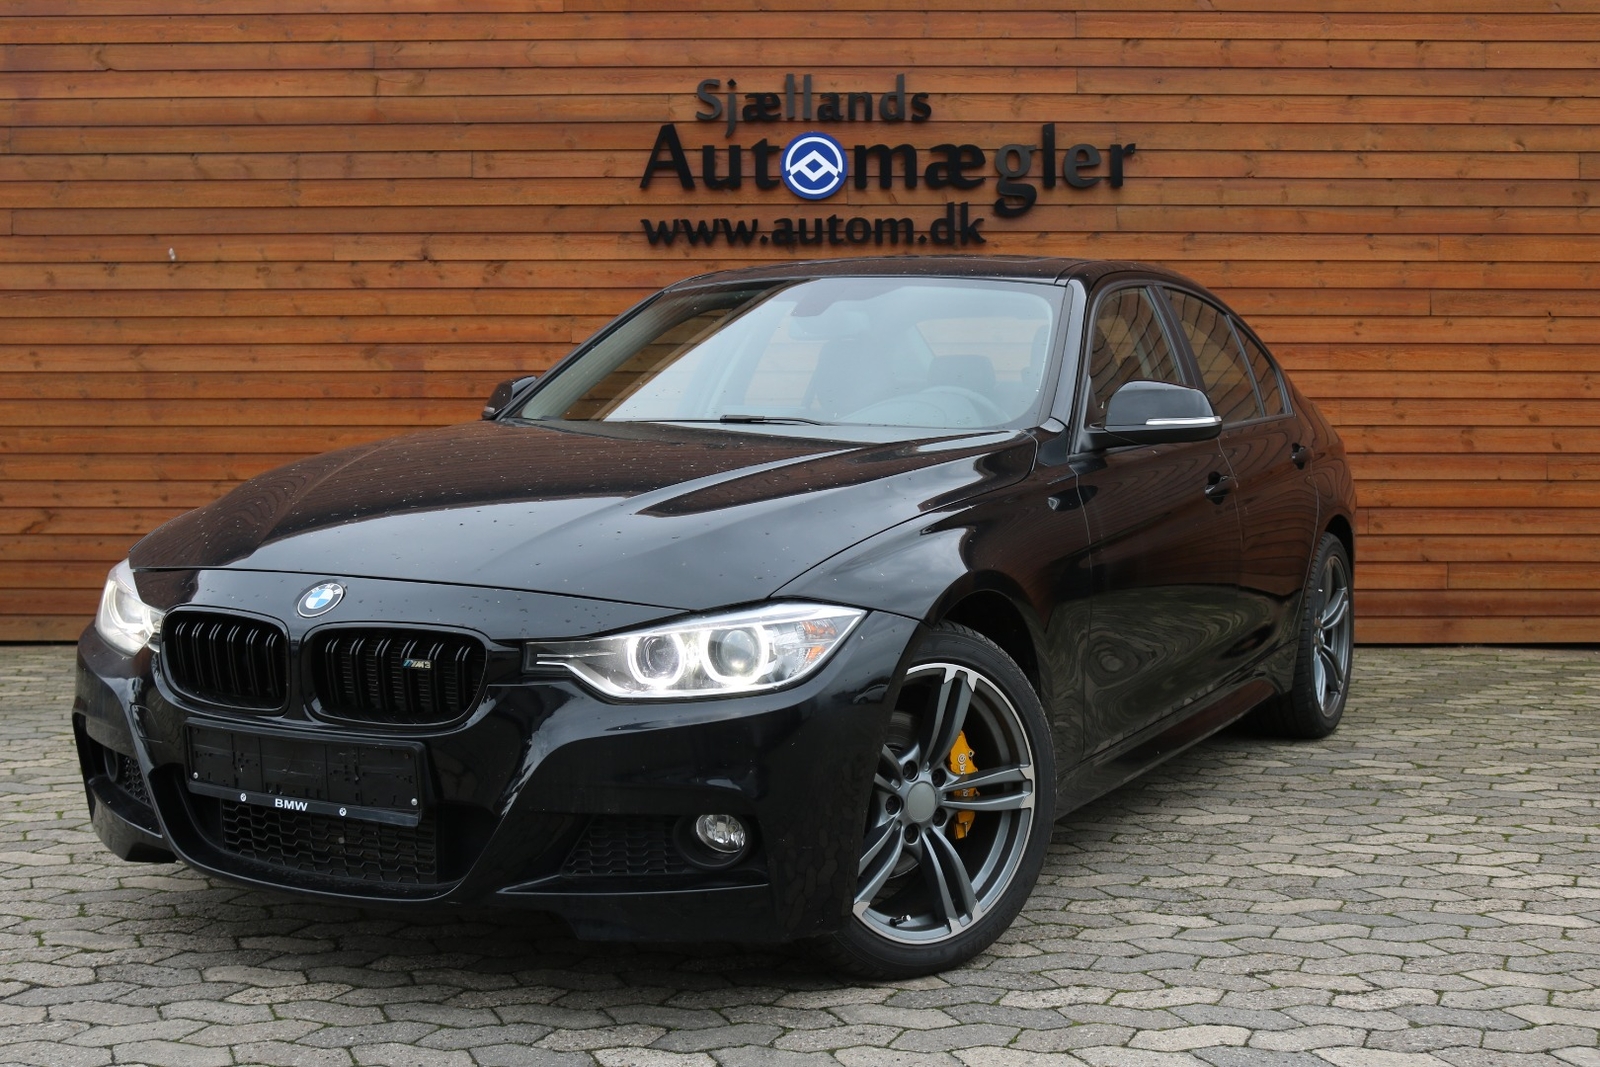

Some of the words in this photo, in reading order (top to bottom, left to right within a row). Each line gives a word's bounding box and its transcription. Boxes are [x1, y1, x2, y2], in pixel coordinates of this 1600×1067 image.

[695, 73, 932, 138] Sjællands
[640, 202, 986, 245] www.autom.dk
[274, 798, 309, 812] BMW
